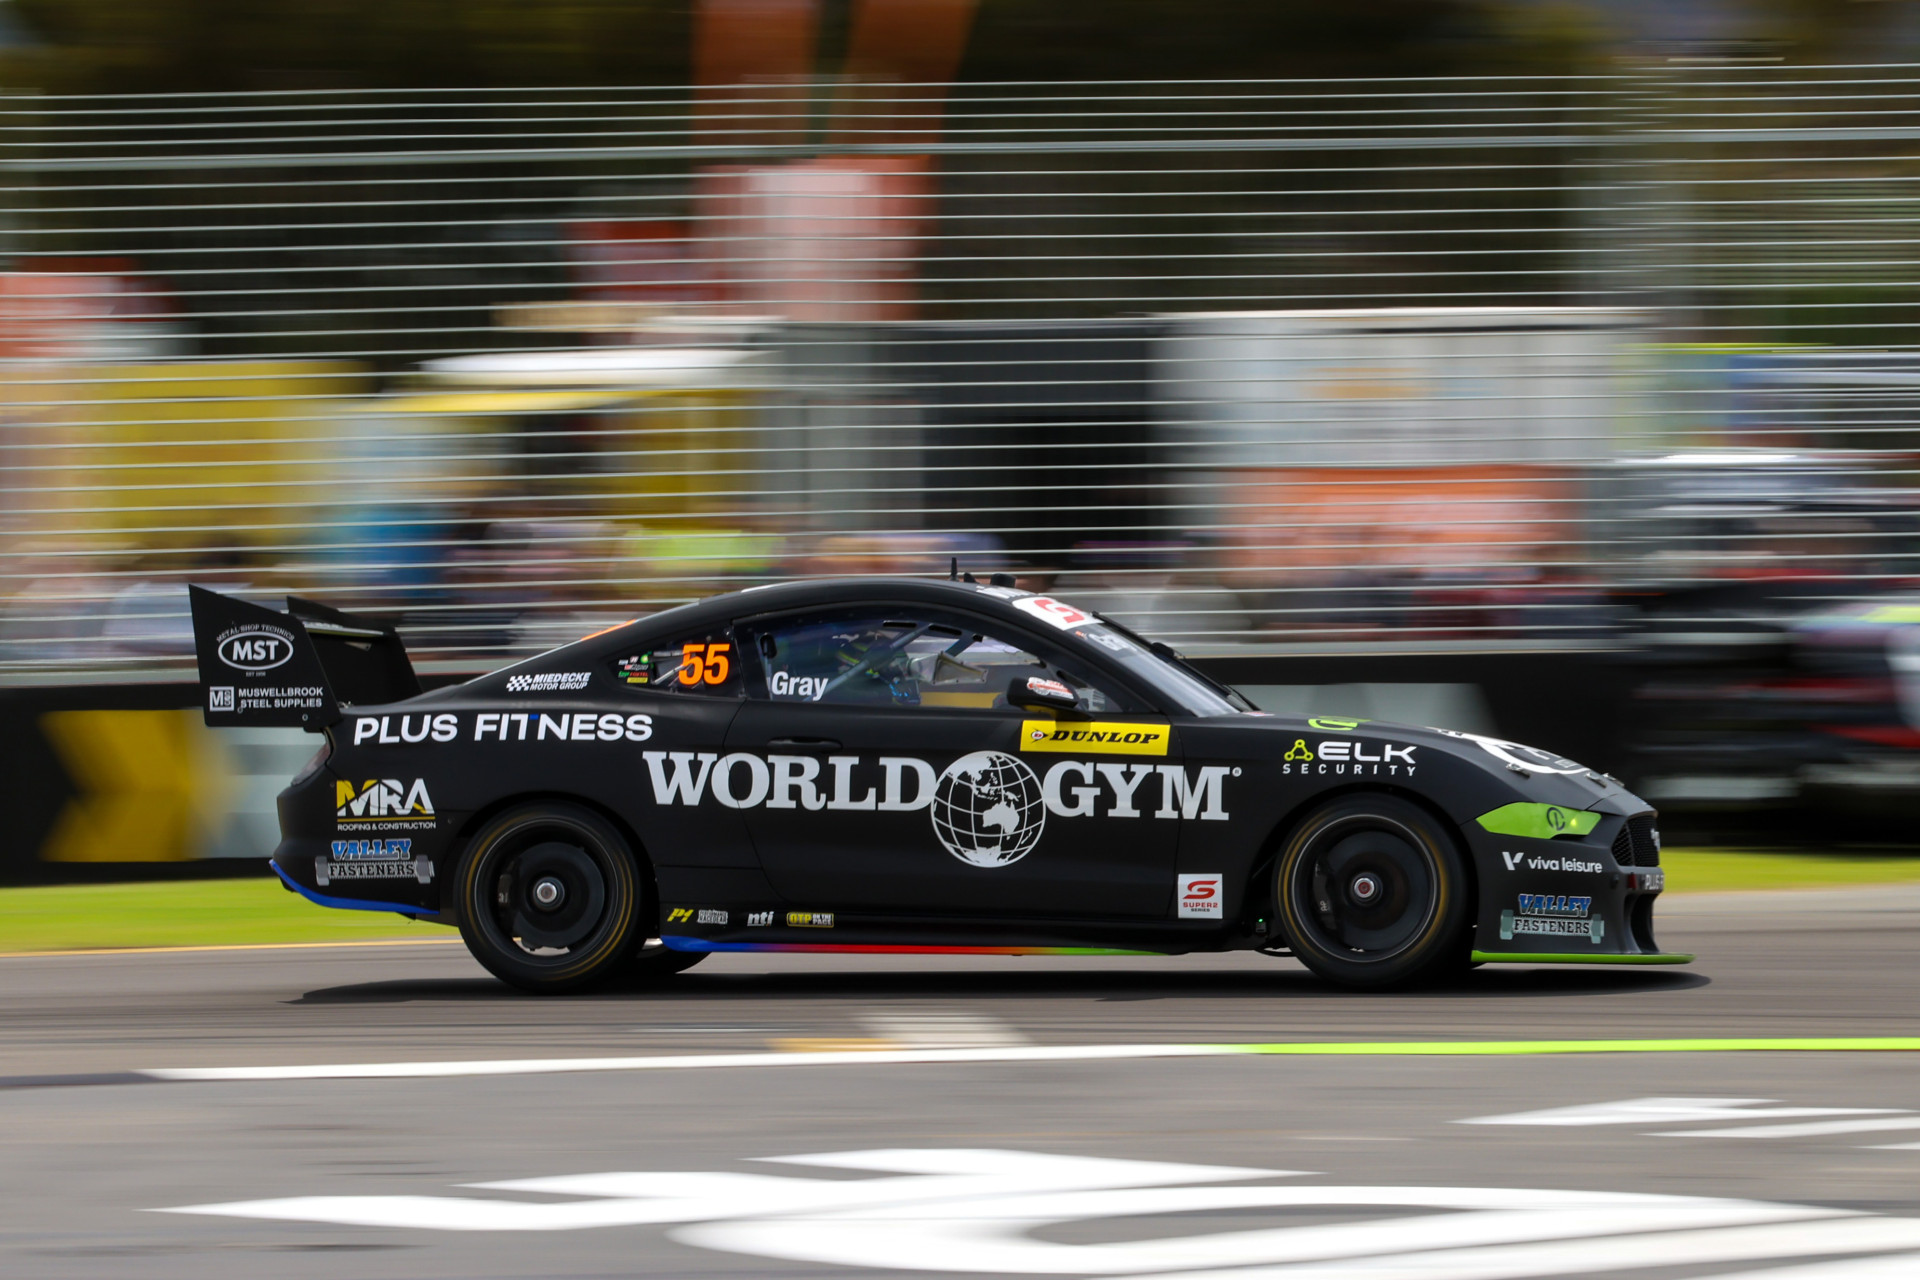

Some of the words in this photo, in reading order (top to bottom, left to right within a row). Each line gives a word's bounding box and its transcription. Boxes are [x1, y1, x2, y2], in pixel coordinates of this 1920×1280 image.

[232, 639, 279, 661] MST
[678, 643, 730, 685] 55
[530, 682, 558, 691] MOTOR
[559, 681, 588, 690] GROUP
[533, 672, 592, 683] MIEDECKE
[771, 671, 829, 701] Gray
[238, 687, 324, 698] MUSWELLBROOK
[240, 699, 272, 708] STEEL
[274, 698, 322, 708] SUPPLIES
[353, 714, 459, 746] PLUS
[473, 713, 653, 742] FITNESS
[1049, 730, 1160, 744] DUNLOP
[1318, 740, 1417, 764] ELK
[1282, 763, 1416, 777] SECURITY
[642, 750, 938, 811] WORLD
[336, 778, 435, 817] MRA
[1042, 760, 1231, 821] GYM
[337, 823, 371, 831] ROOFING
[378, 821, 436, 830] CONSTRUCTION
[331, 838, 412, 861] VALLEY
[329, 863, 415, 878] FASTENERS
[1527, 856, 1560, 871] viva
[1561, 857, 1602, 873] leisure
[1518, 893, 1592, 918] VALLEY
[667, 908, 694, 922] P1
[1514, 917, 1590, 934] FASTENERS
